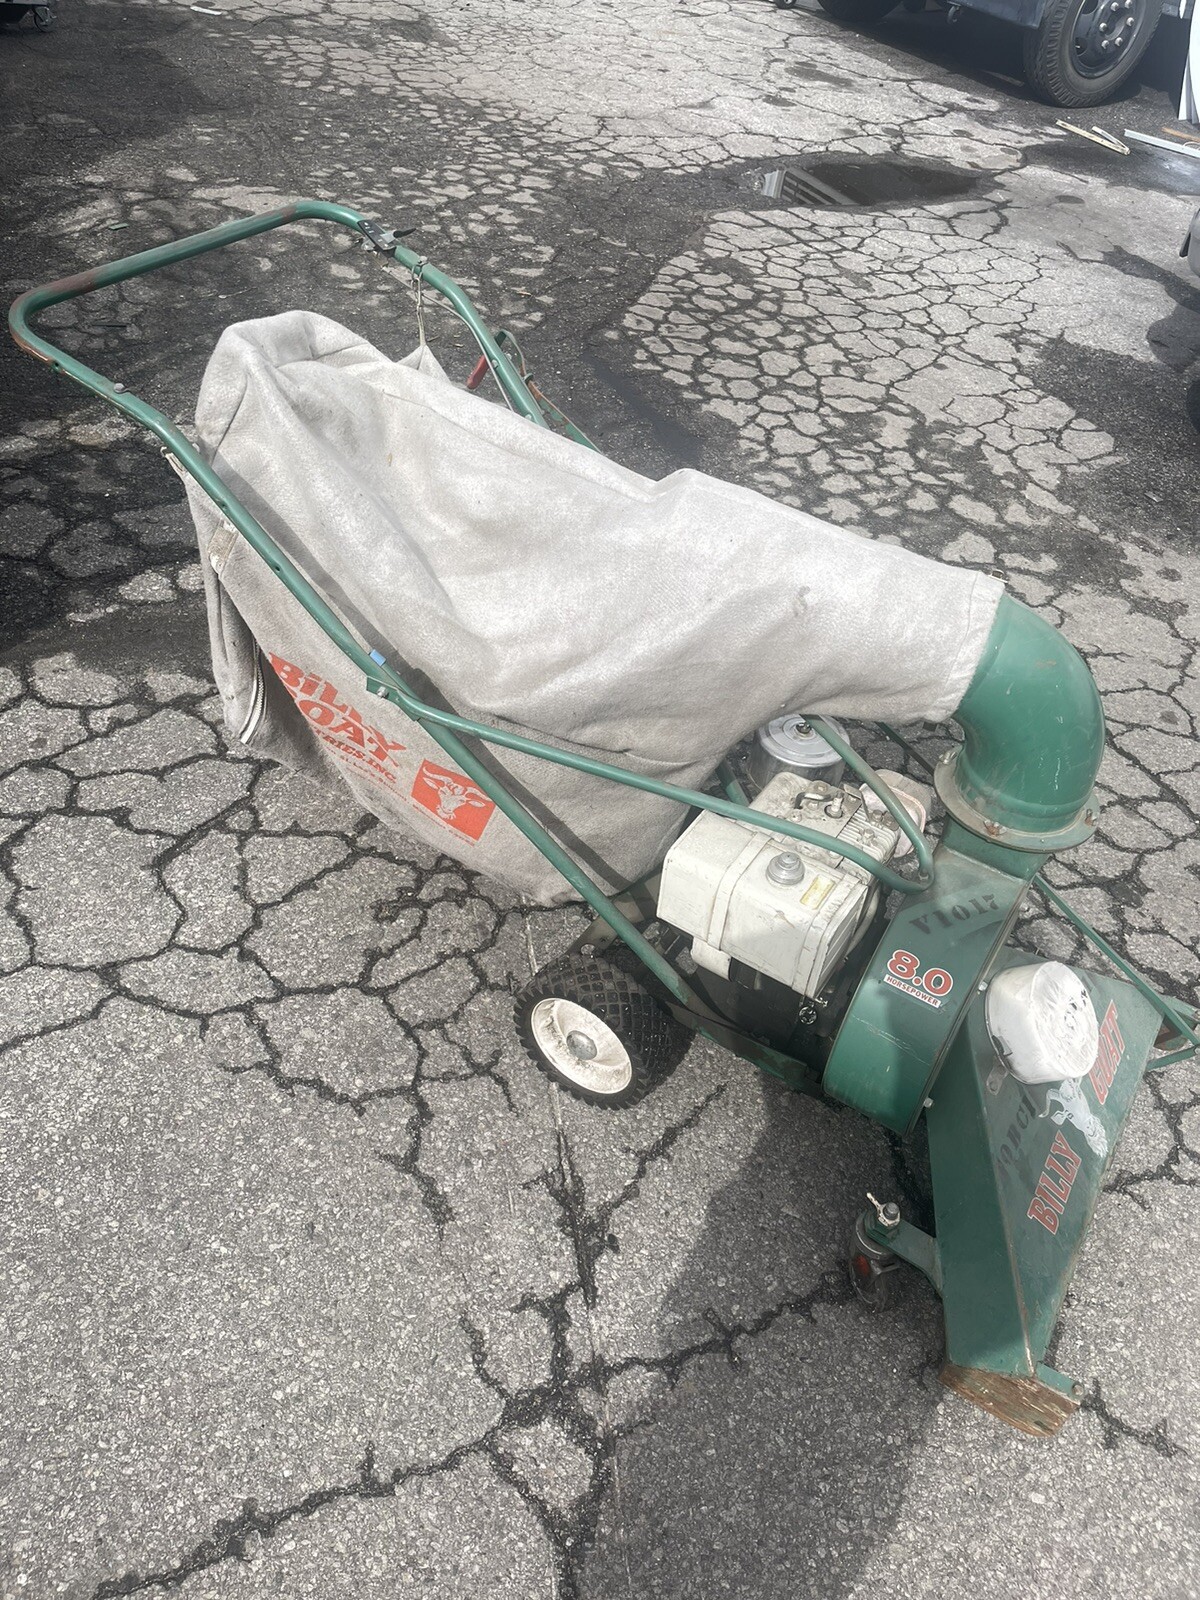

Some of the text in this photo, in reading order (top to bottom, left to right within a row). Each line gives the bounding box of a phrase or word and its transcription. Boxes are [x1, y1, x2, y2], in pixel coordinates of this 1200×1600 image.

[282, 681, 400, 768] OAT
[885, 975, 940, 1008] HORSEPOWER
[887, 949, 954, 997] 8.0
[1087, 999, 1126, 1106] GOAT
[1026, 1129, 1083, 1236] BILLY
